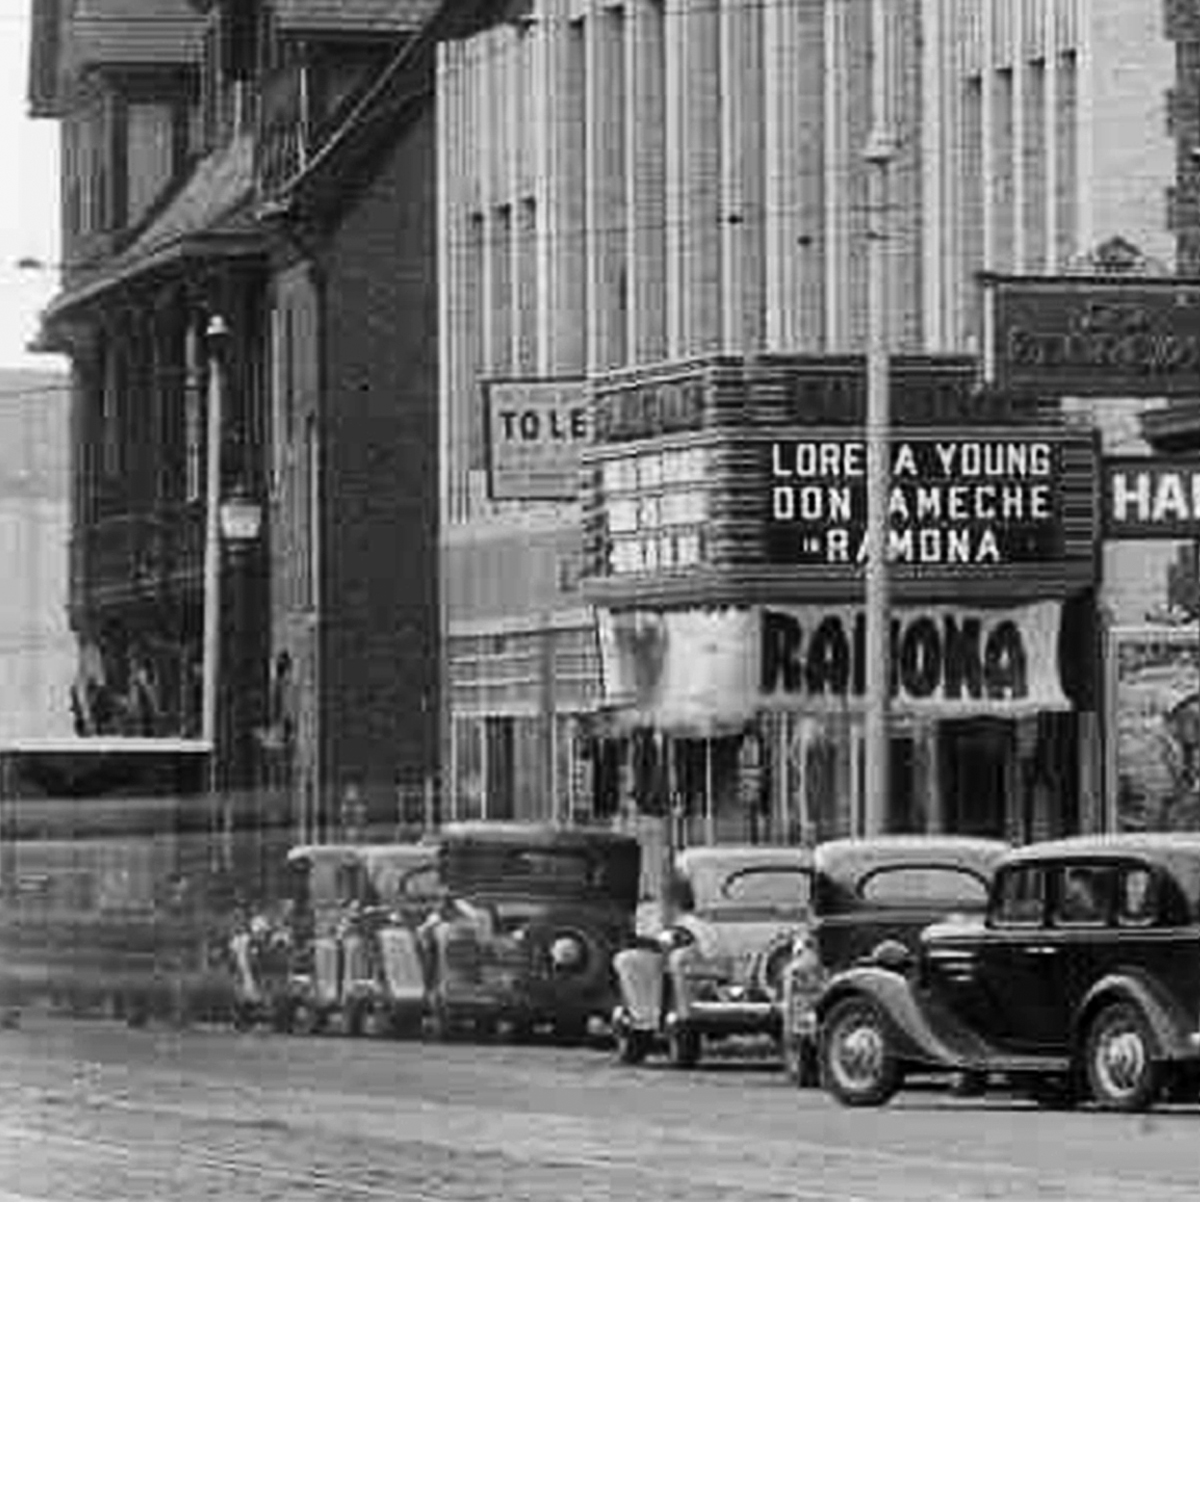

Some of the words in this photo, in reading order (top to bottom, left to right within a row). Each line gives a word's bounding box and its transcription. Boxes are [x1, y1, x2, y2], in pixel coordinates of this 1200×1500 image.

[499, 411, 540, 441] TO
[548, 408, 588, 440] LE
[772, 443, 918, 476] LOREA
[935, 442, 1051, 476] YOUNG
[772, 486, 850, 520] DON
[885, 485, 1052, 519] AMECHE
